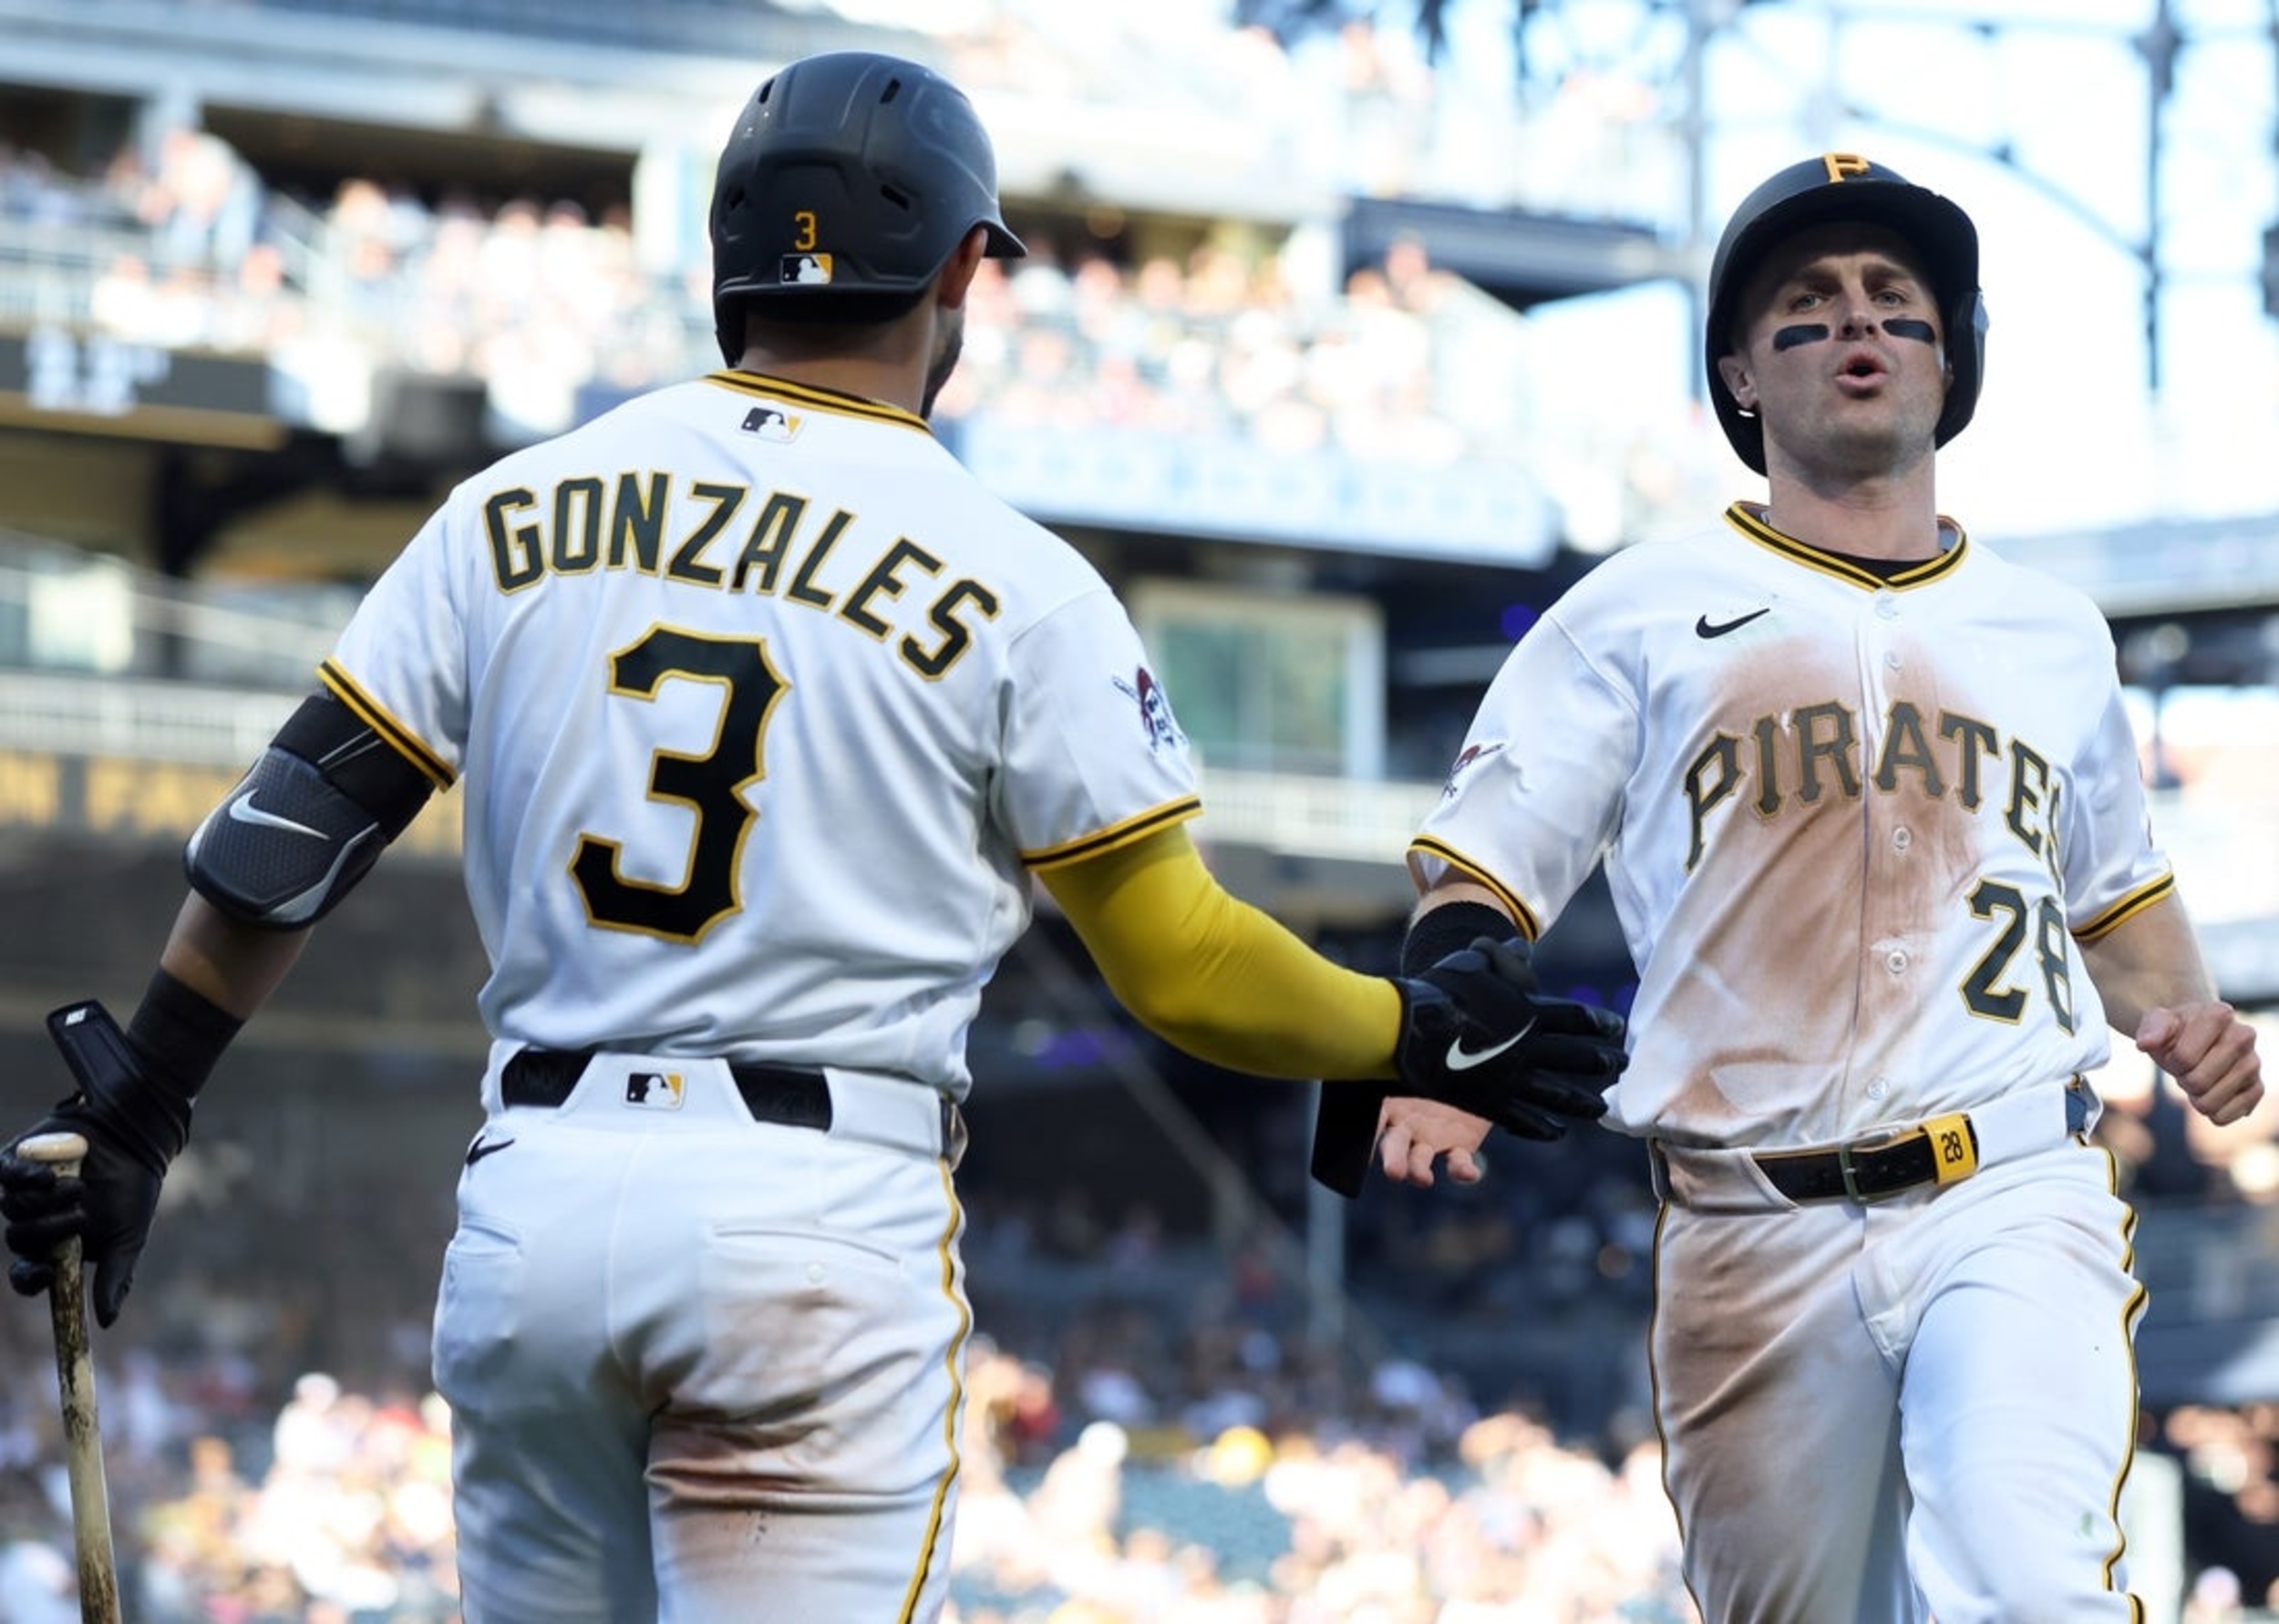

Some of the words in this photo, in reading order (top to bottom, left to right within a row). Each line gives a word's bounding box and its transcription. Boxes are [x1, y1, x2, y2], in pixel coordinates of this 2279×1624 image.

[1822, 153, 1870, 183] P
[794, 211, 816, 252] 3
[483, 470, 1002, 682] GONZALES
[567, 622, 791, 946] 3
[1959, 877, 2076, 1037] 28
[1941, 1130, 1964, 1163] 28
